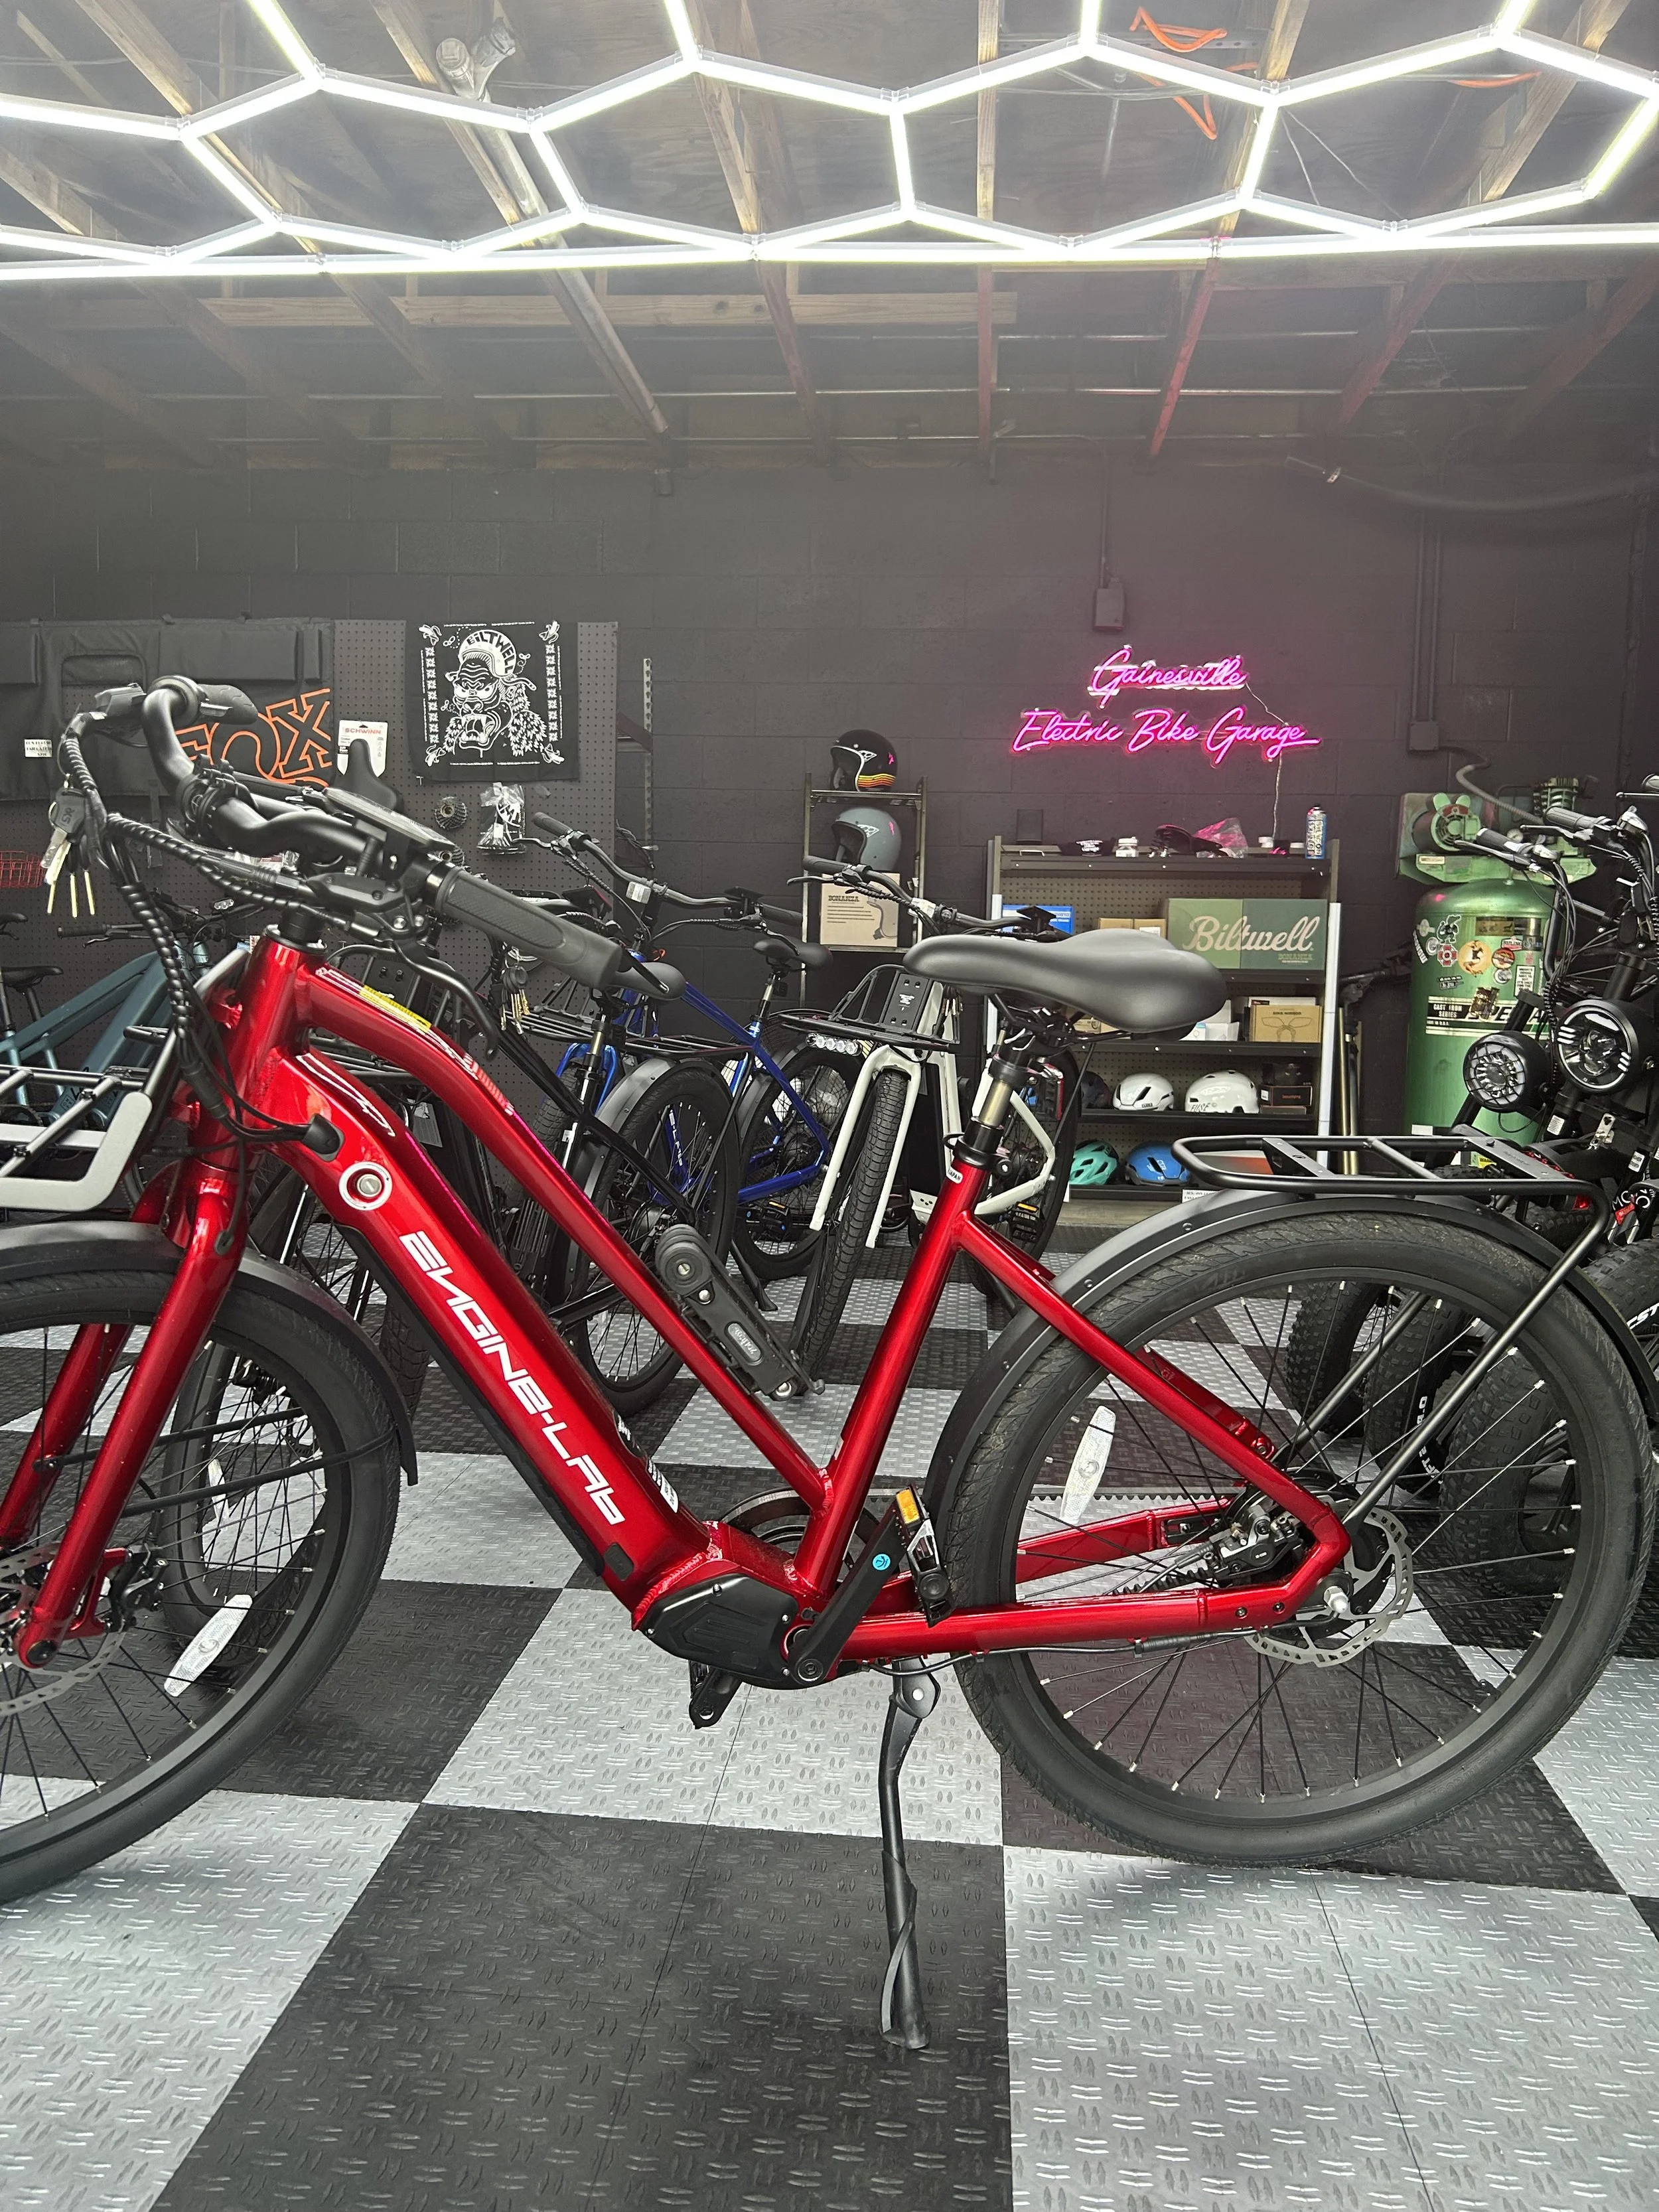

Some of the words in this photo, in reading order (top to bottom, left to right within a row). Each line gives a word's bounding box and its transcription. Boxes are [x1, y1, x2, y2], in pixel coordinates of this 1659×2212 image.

[1092, 647, 1248, 707] Gainesville
[1012, 709, 1125, 753] Electric
[1127, 708, 1200, 753] Bike
[1206, 706, 1323, 765] Garage
[1182, 915, 1321, 952] Biltwell
